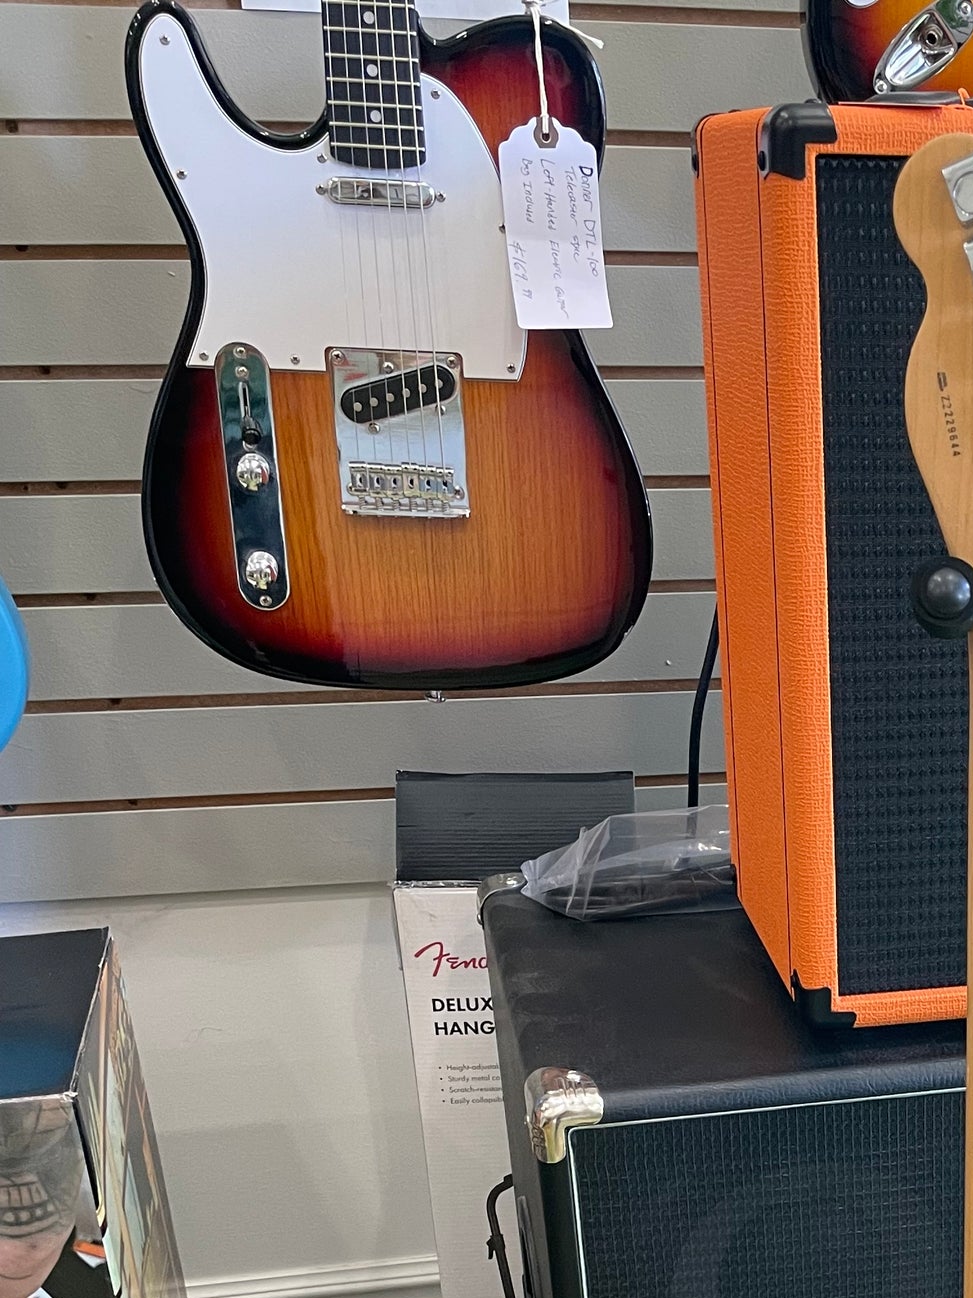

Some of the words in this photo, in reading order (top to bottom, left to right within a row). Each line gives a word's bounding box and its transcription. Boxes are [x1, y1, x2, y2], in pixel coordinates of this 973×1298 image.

[520, 158, 533, 176] Bag
[578, 165, 594, 212] Donner
[583, 219, 599, 278] DTL-100
[431, 996, 494, 1013] DELUX
[434, 1020, 496, 1036] HANG
